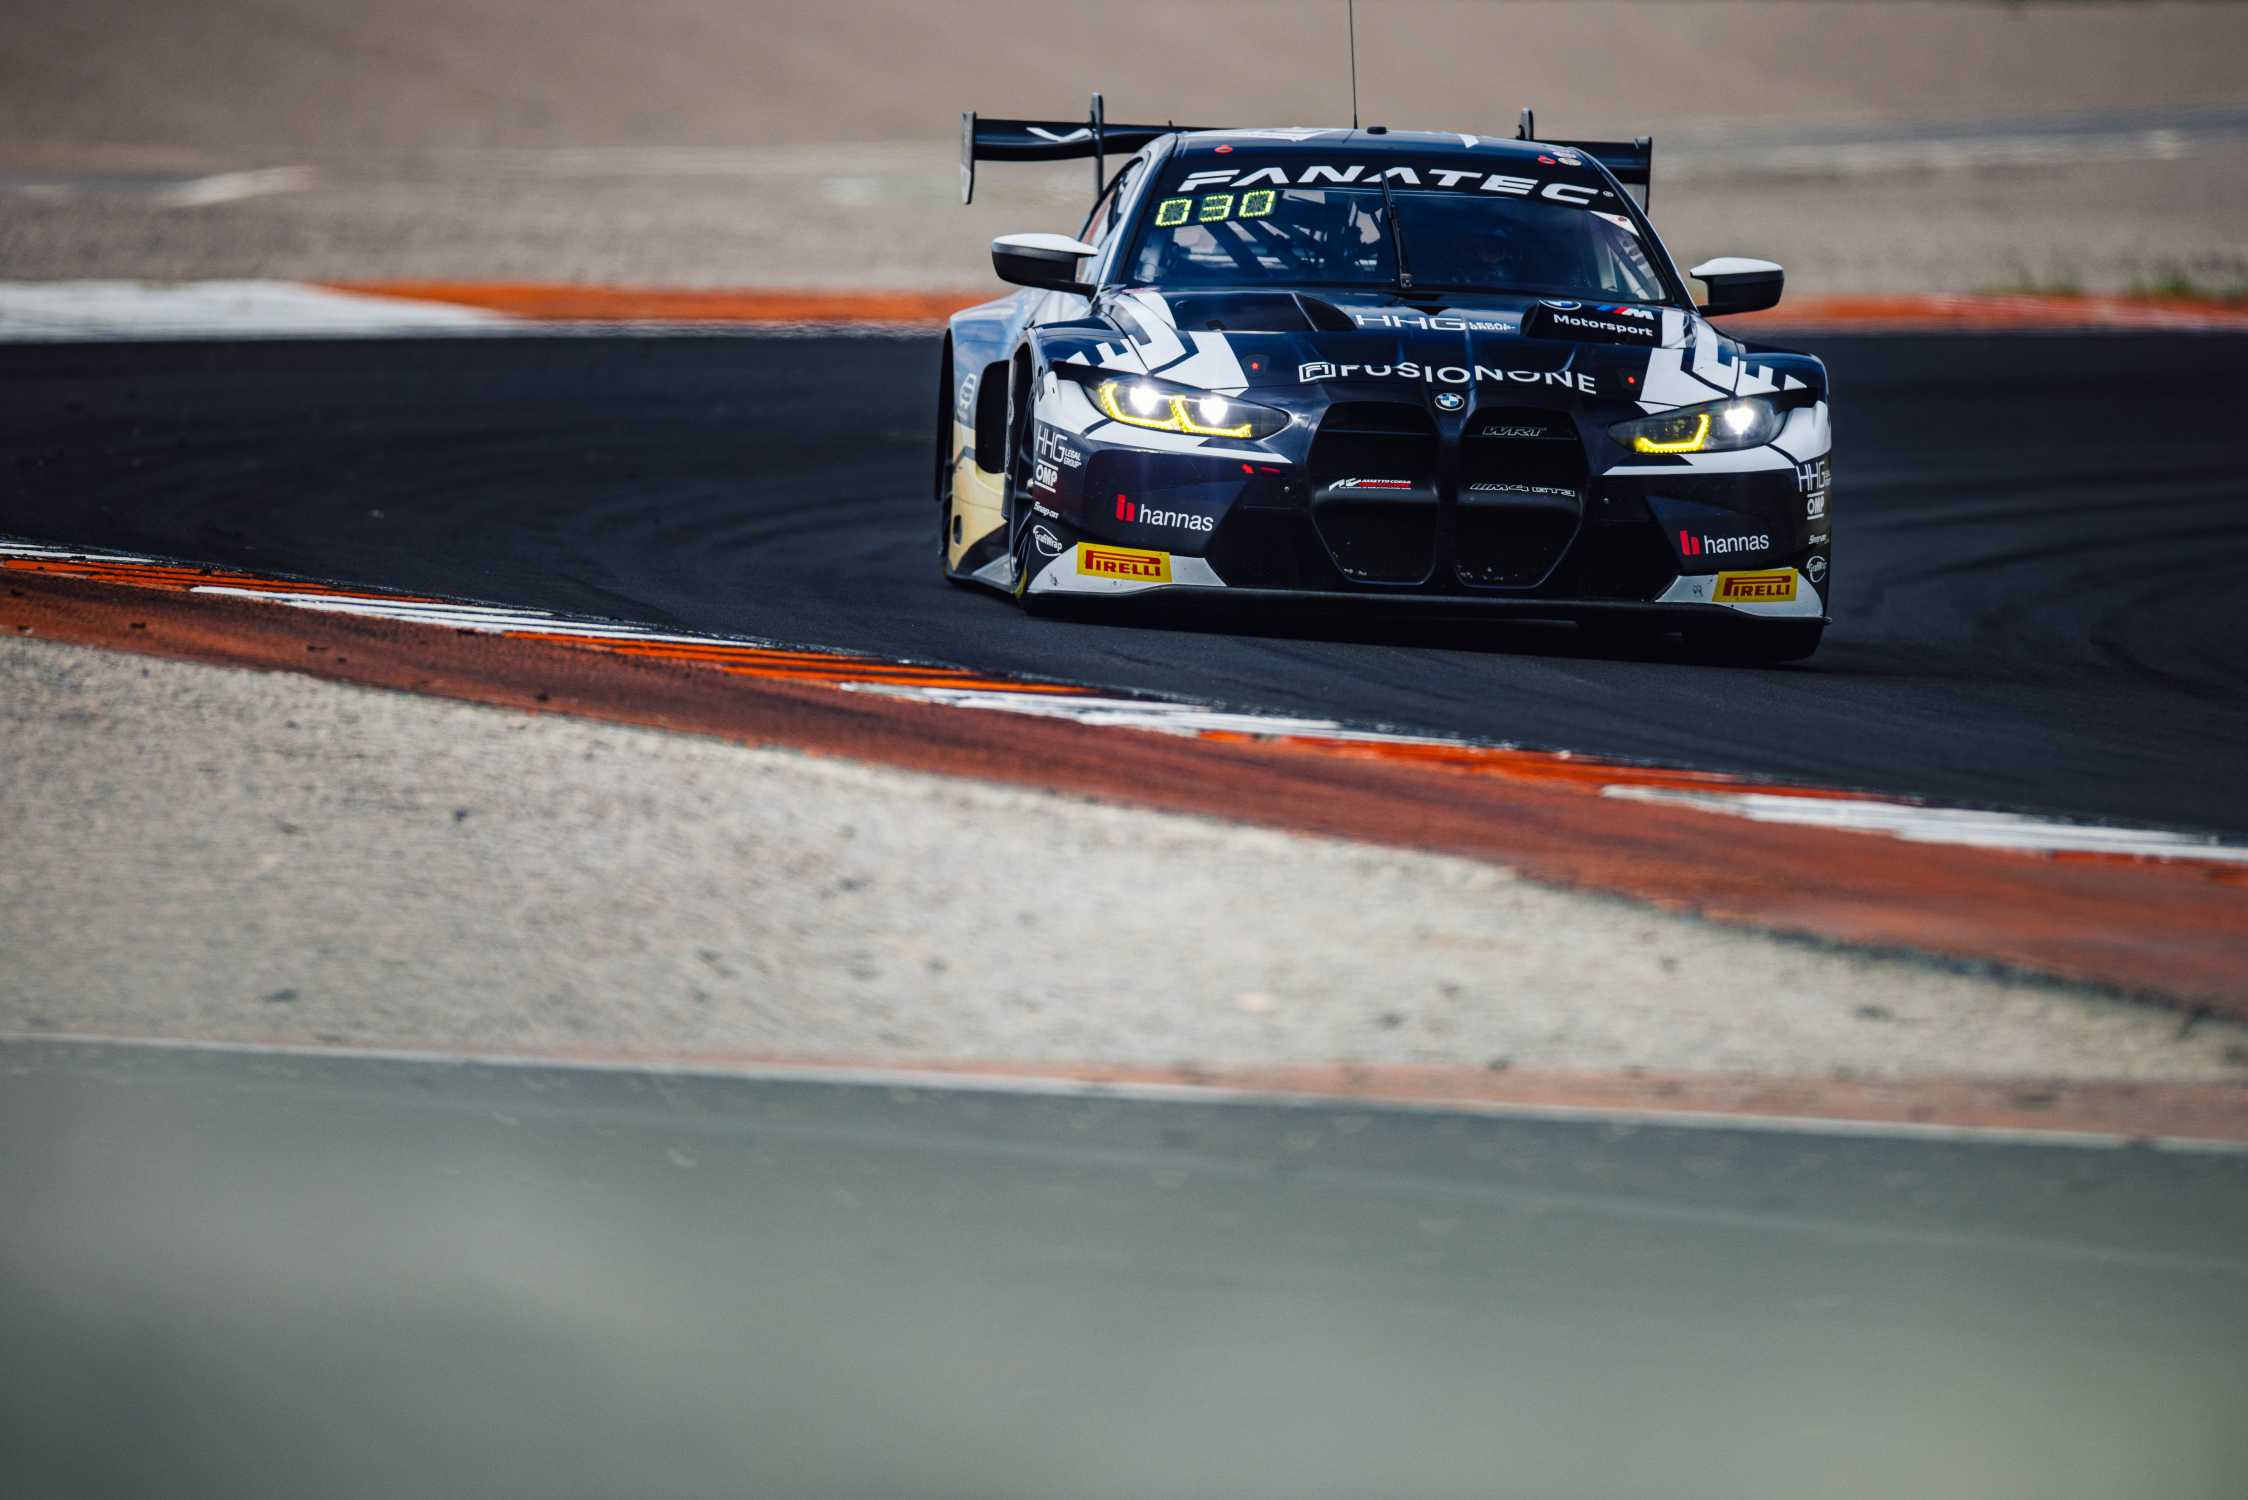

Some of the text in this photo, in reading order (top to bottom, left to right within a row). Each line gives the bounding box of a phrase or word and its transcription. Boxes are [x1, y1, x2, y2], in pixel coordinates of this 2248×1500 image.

[1177, 165, 1599, 205] FANATEC
[1155, 191, 1276, 226] 030
[1355, 314, 1467, 331] HHG
[1553, 314, 1654, 337] Motorsport
[1036, 425, 1068, 463] HHG
[1035, 464, 1058, 487] OMP
[1139, 503, 1214, 532] hannas
[1703, 534, 1770, 555] hannas
[1085, 549, 1161, 577] PIRELLI
[1722, 575, 1792, 597] PIRELLI
